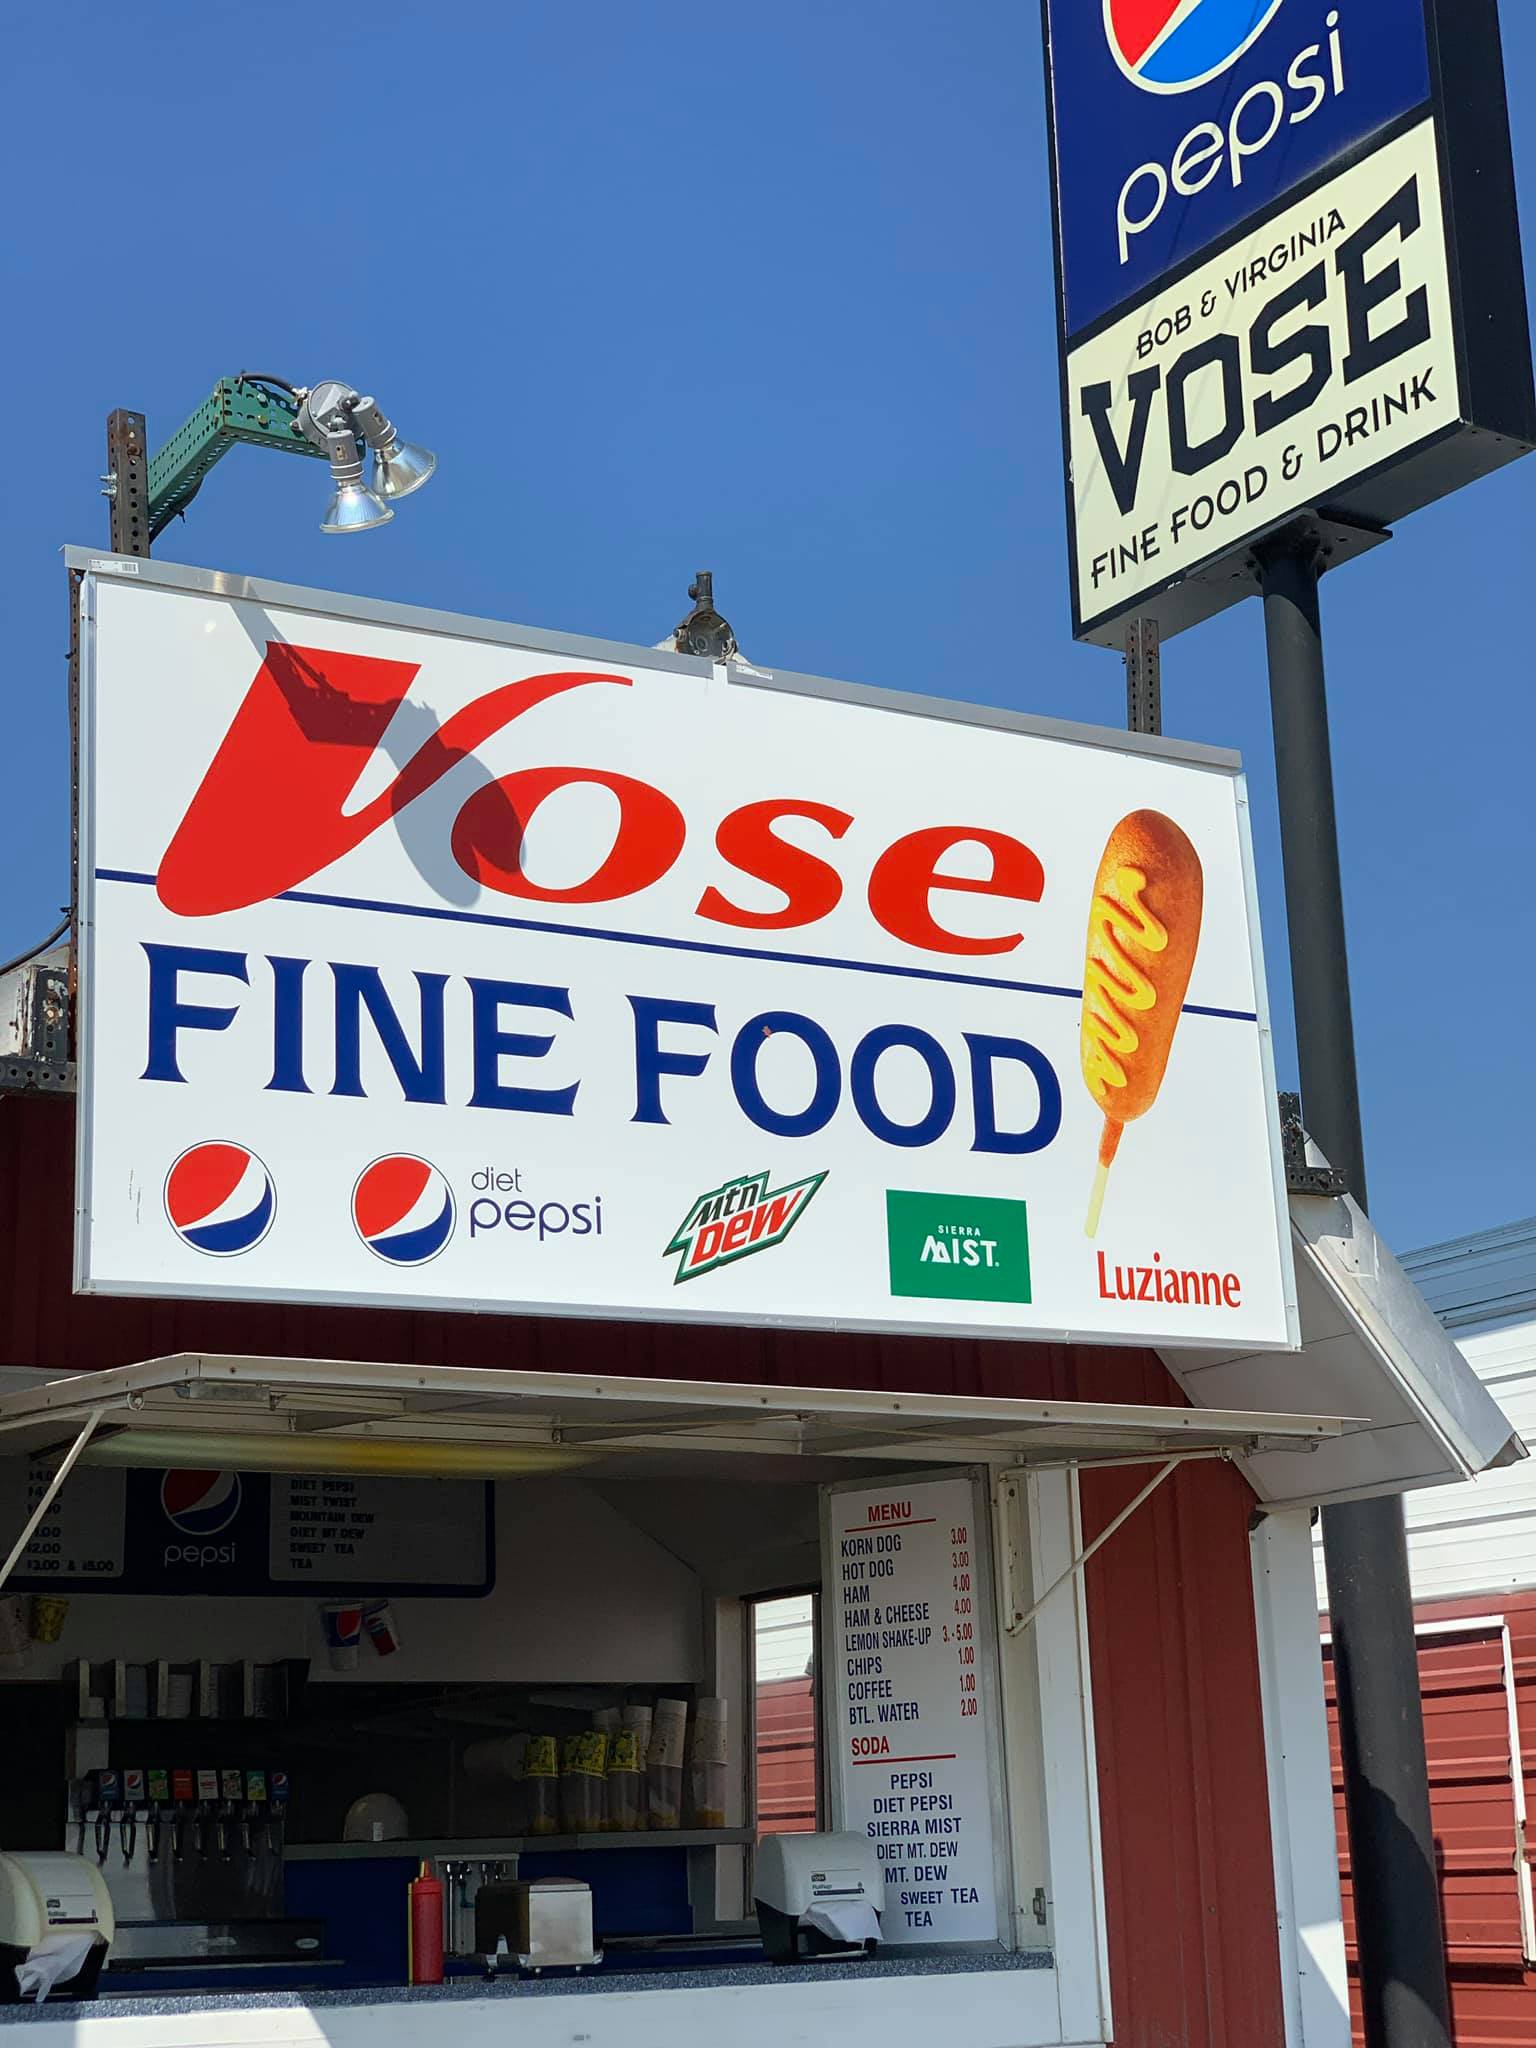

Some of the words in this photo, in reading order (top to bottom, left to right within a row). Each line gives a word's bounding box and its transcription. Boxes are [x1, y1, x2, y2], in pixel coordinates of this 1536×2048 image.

[1117, 11, 1344, 264] pepsi
[1135, 311, 1192, 359] BOB
[1200, 290, 1217, 319] &
[1224, 208, 1346, 300] VIRGINIA
[1081, 172, 1431, 515] VOSE
[1090, 524, 1161, 589] FINE
[1170, 466, 1268, 545] FOOD
[1282, 445, 1302, 481] &
[1317, 366, 1438, 462] DRINK
[155, 641, 1046, 956] Vose
[139, 943, 581, 1117] FINE
[627, 995, 1062, 1156] FOOD
[471, 1167, 522, 1193] diet
[470, 1196, 603, 1241] pepsi
[686, 1183, 760, 1232] Mtn
[938, 1224, 981, 1237] SIERRA
[1097, 1251, 1242, 1307] Luzianne
[290, 1511, 345, 1522] MOUNTAIN
[868, 1501, 912, 1523] MENU
[290, 1527, 317, 1537] DIET
[841, 1538, 873, 1557] KORN
[877, 1534, 901, 1553] DOG
[951, 1527, 967, 1545] 3.00
[164, 1541, 236, 1568] pepsi
[290, 1543, 326, 1553] SWEET
[334, 1544, 354, 1554] TEA
[290, 1558, 312, 1568] TEA
[842, 1562, 864, 1580] HOT
[870, 1559, 894, 1578] DOG
[952, 1552, 969, 1568] 3.00
[843, 1585, 870, 1604] HAM
[953, 1575, 970, 1591] 4.00
[845, 1609, 869, 1628] HAM
[875, 1608, 882, 1625] &
[886, 1603, 929, 1624] CHEESE
[954, 1598, 971, 1615] 4.00
[846, 1631, 879, 1652] LEMON
[882, 1627, 931, 1649] SHAKE-UP
[956, 1623, 973, 1641] 5.00
[847, 1656, 882, 1676] CHIPS
[958, 1647, 974, 1665] 1.00
[848, 1680, 892, 1701] COFFEE
[960, 1674, 976, 1692] 1.00
[850, 1706, 874, 1725] BTL.
[878, 1702, 919, 1722] WATER
[961, 1698, 977, 1716] 2.00
[851, 1736, 890, 1756] SODA
[890, 1772, 932, 1790] PEPSI
[873, 1797, 904, 1814] DIET
[910, 1794, 952, 1812] PEPSI
[867, 1820, 920, 1837] SIERRA
[925, 1817, 962, 1834] MIST
[877, 1843, 903, 1860] DIET
[907, 1842, 927, 1859] MT.
[930, 1841, 958, 1857] DEW
[885, 1867, 909, 1883] MT.
[914, 1865, 947, 1882] DEW
[900, 1890, 943, 1905] SWEET
[950, 1887, 979, 1903] TEA
[905, 1911, 933, 1927] TEA
